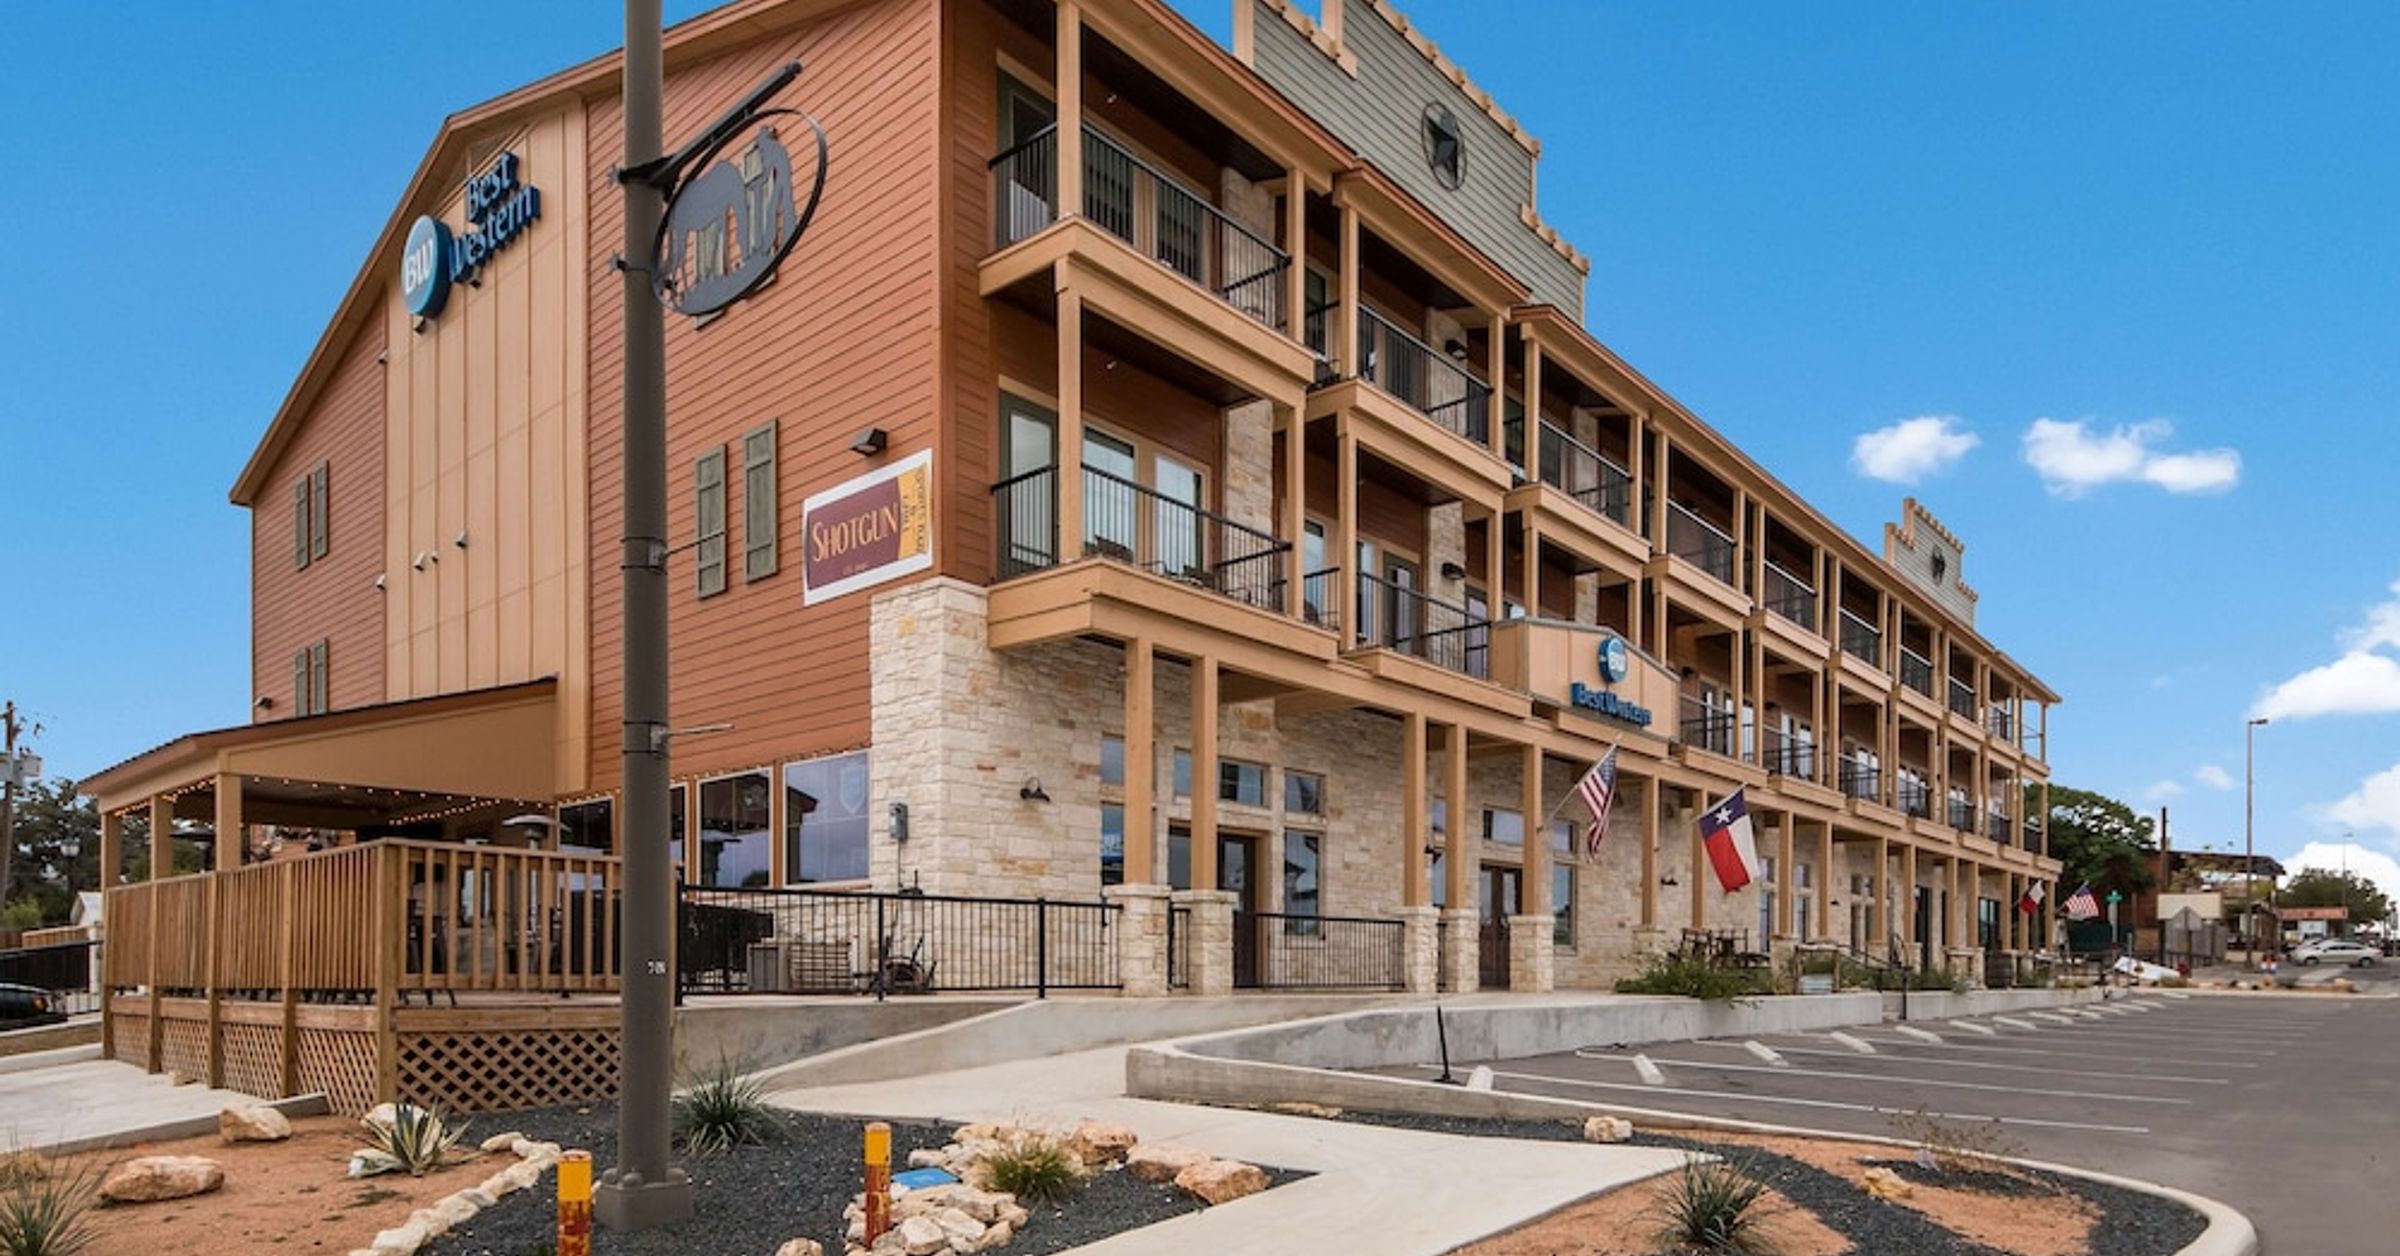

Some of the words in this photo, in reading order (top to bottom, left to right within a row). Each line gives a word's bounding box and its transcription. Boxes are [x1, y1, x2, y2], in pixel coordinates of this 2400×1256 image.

[466, 151, 517, 222] Best
[449, 185, 539, 282] Western
[404, 238, 434, 296] BW
[812, 501, 898, 562] SHOTGUN
[1571, 683, 1606, 711] Best
[1605, 692, 1652, 725] Western
